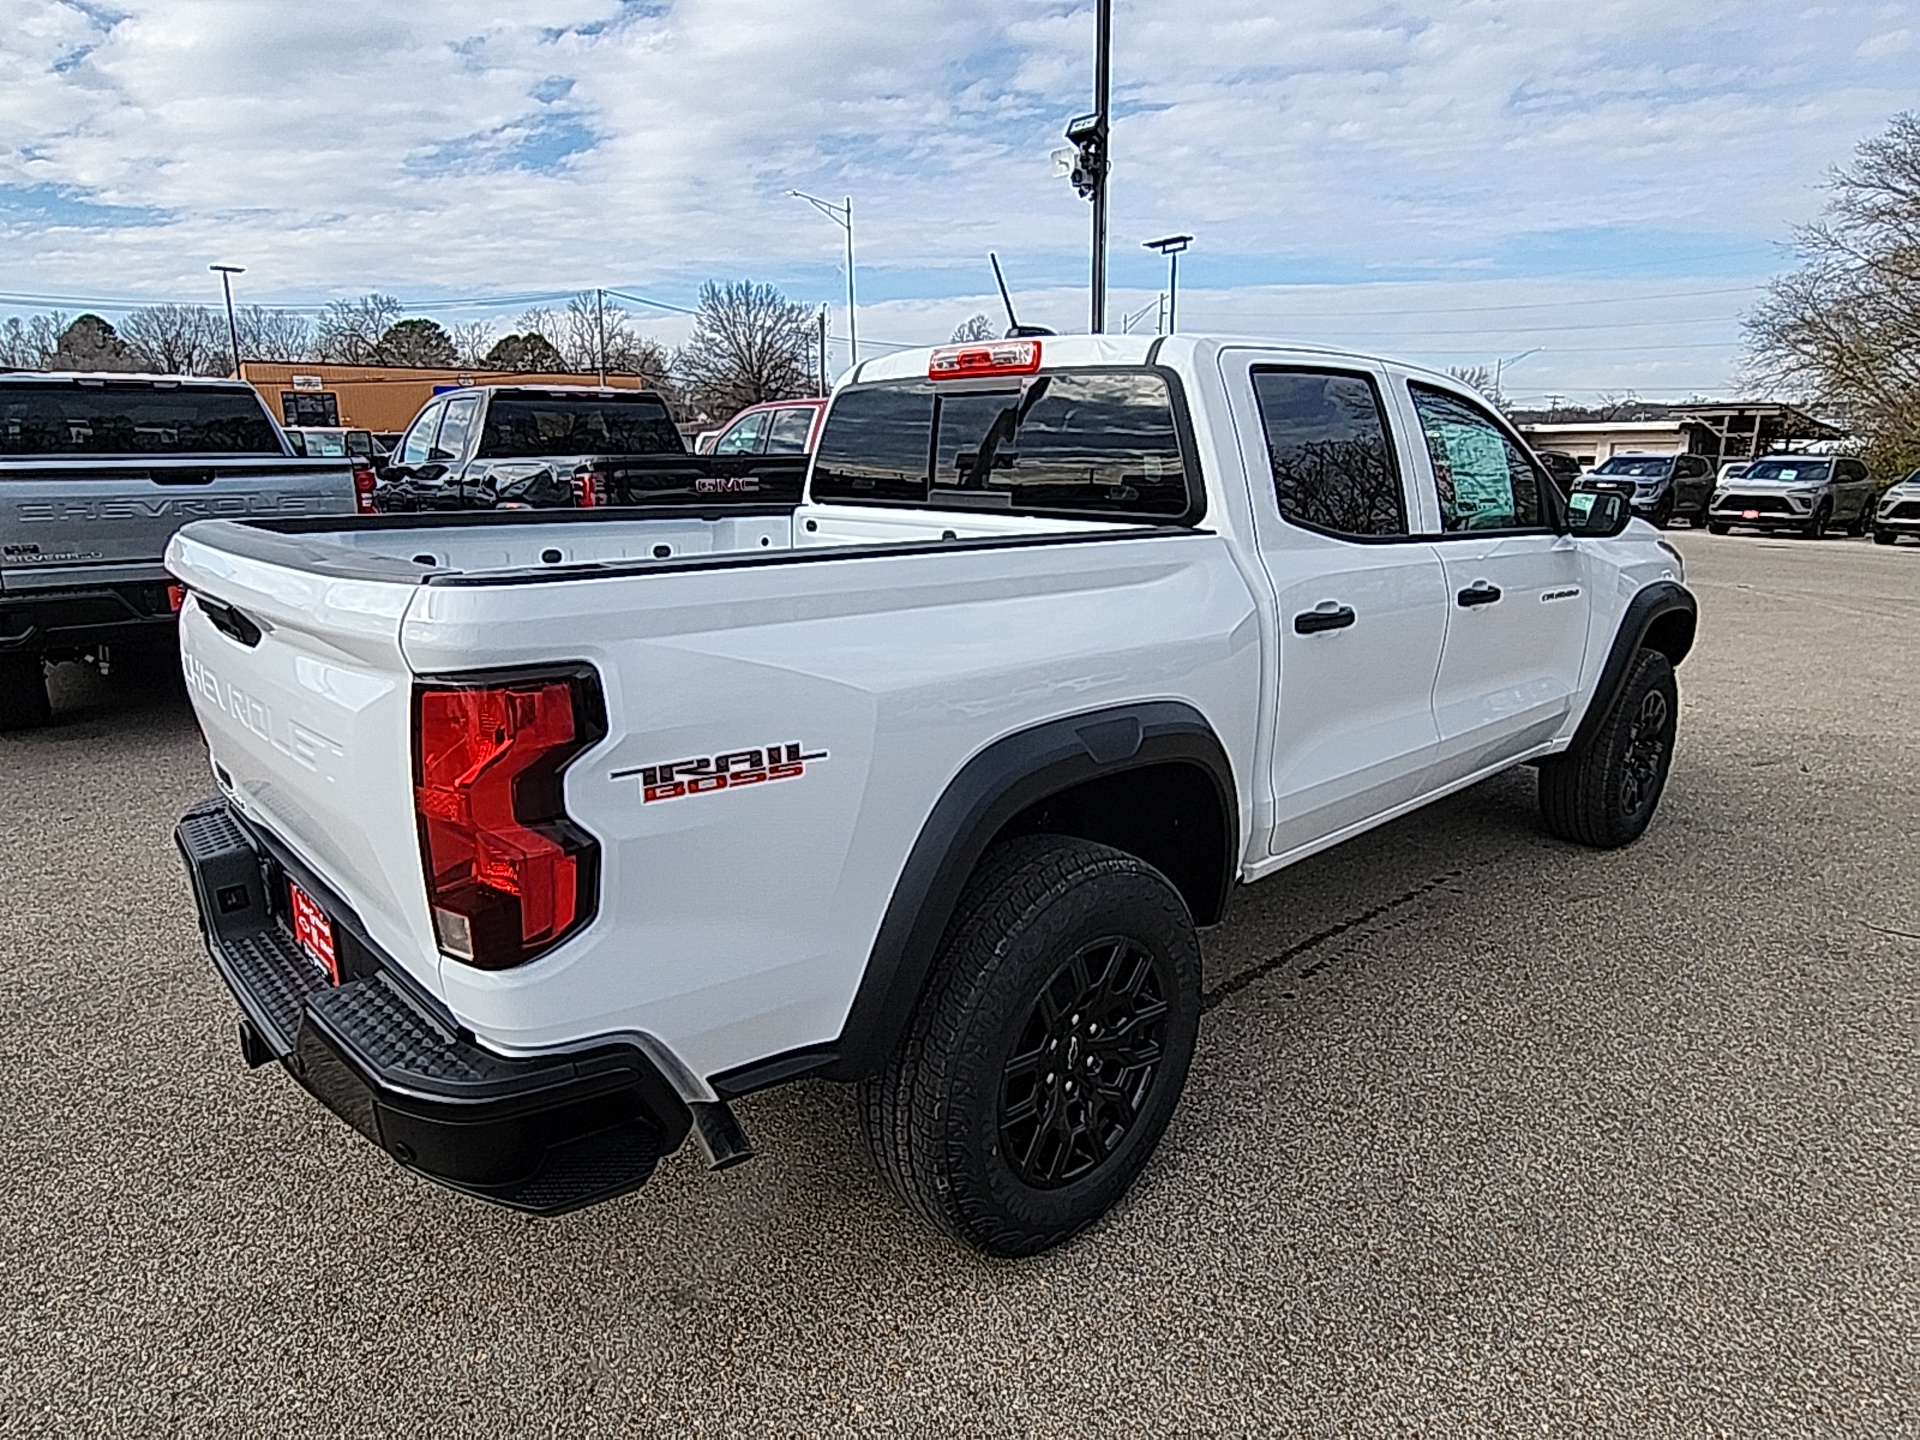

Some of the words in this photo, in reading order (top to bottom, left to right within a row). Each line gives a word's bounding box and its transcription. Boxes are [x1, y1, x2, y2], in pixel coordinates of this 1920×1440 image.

[18, 488, 336, 522] CHEVROLET
[696, 477, 760, 493] GMC
[182, 653, 344, 784] CHEVROLET
[610, 742, 828, 787] TRAIL
[643, 761, 804, 804] BOSS
